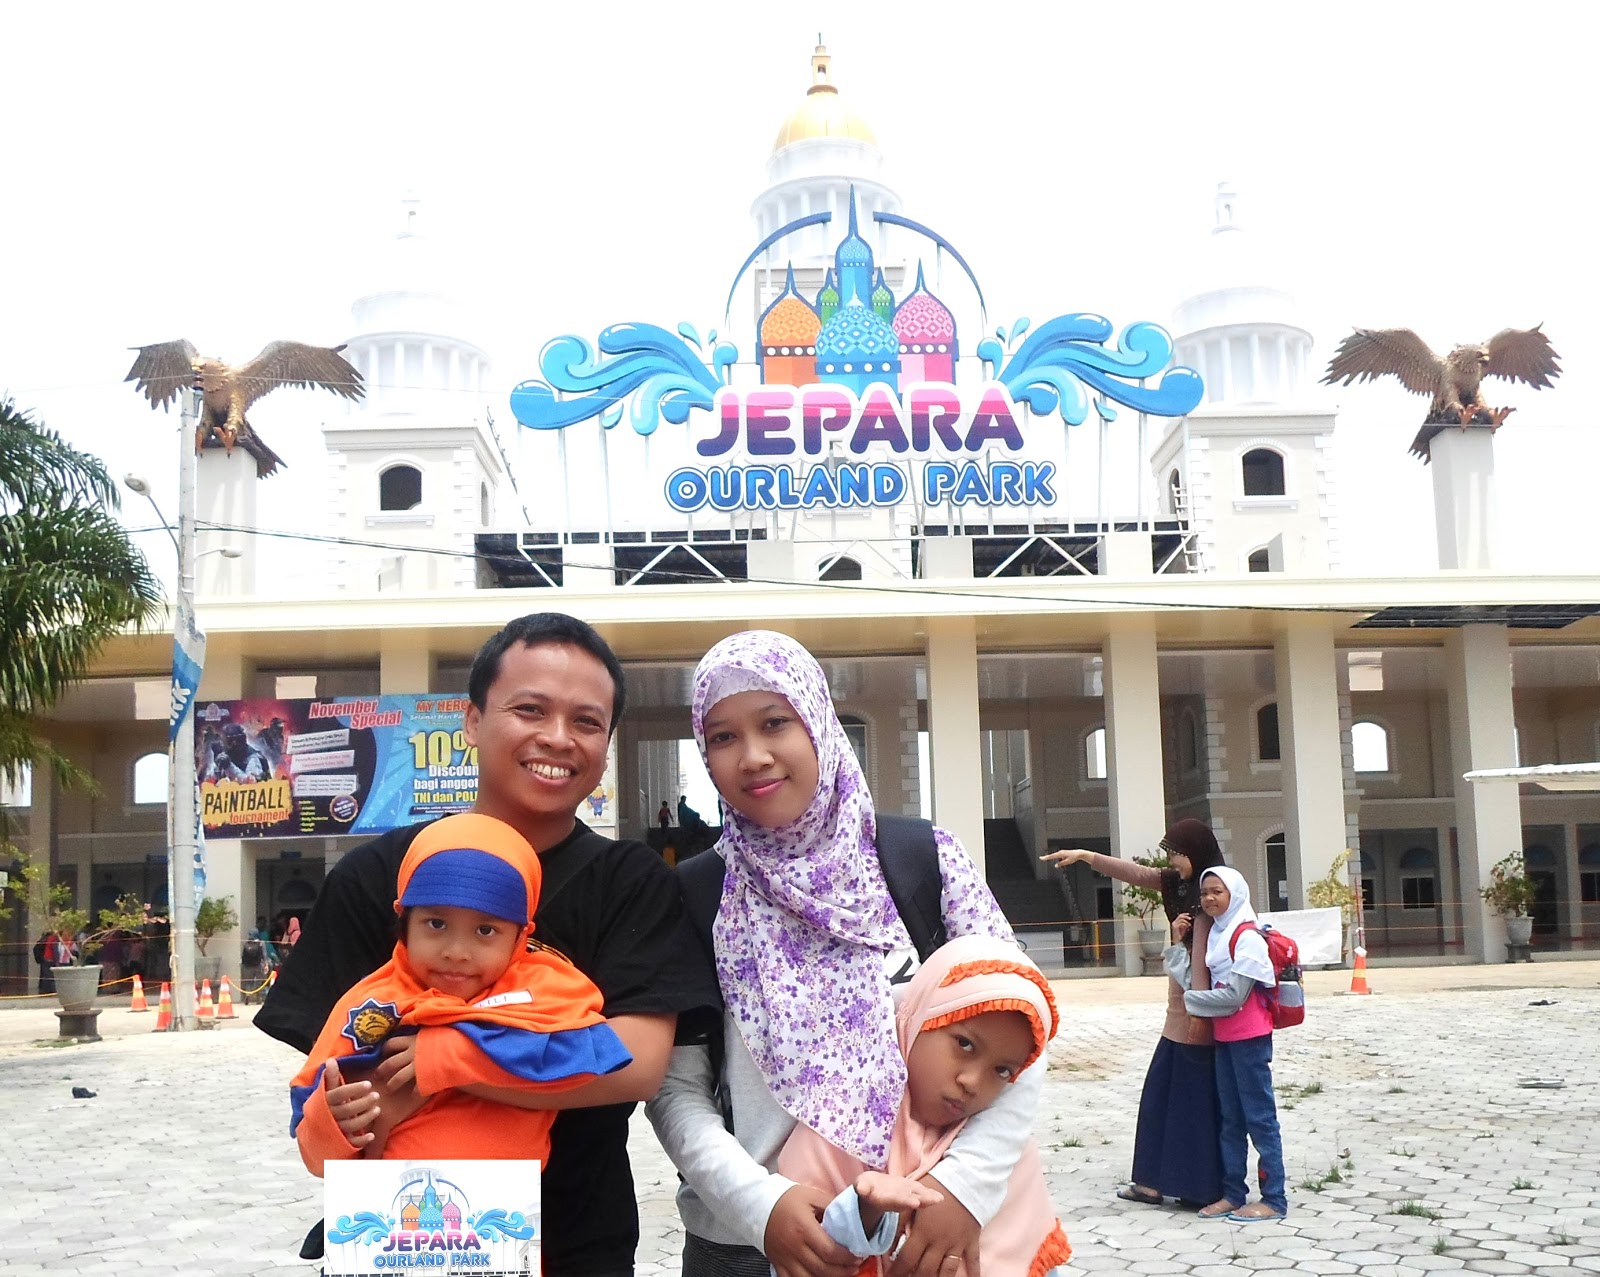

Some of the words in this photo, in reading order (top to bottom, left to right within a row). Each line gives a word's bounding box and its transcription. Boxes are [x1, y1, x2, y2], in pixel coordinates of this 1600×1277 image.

[696, 387, 1025, 456] JEPARA
[665, 463, 908, 513] OURLAND
[923, 461, 1057, 508] PARK
[308, 700, 379, 720] November
[416, 700, 433, 712] MY
[351, 710, 403, 730] Special
[409, 730, 478, 769] 10%
[414, 778, 438, 790] bagi
[413, 793, 431, 803] TNI
[433, 792, 453, 803] dan
[229, 809, 290, 825] tournament
